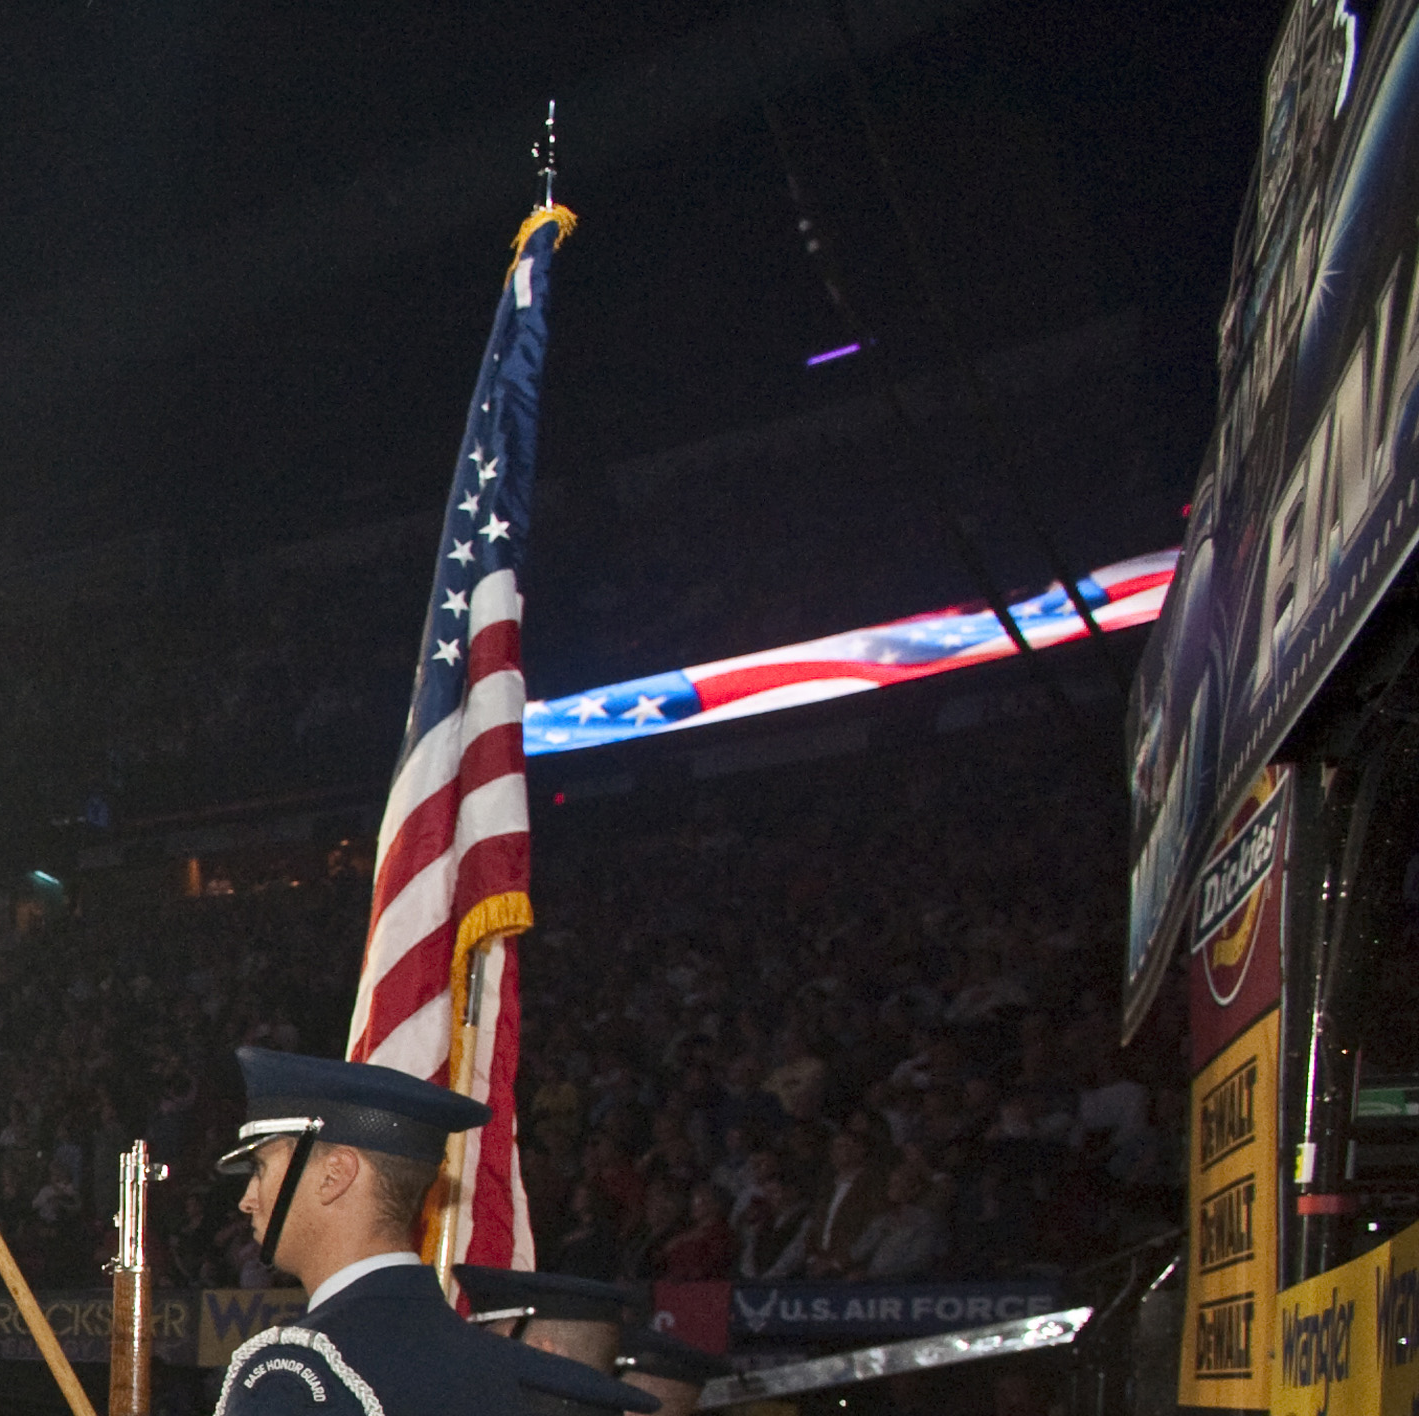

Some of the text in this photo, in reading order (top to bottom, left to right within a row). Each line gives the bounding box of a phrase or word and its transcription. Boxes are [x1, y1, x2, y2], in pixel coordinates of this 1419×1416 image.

[1199, 808, 1279, 928] Dickies
[779, 1295, 1054, 1321] U.S. AIR FORCE
[243, 1358, 327, 1402] BASE HONOR GUARD
